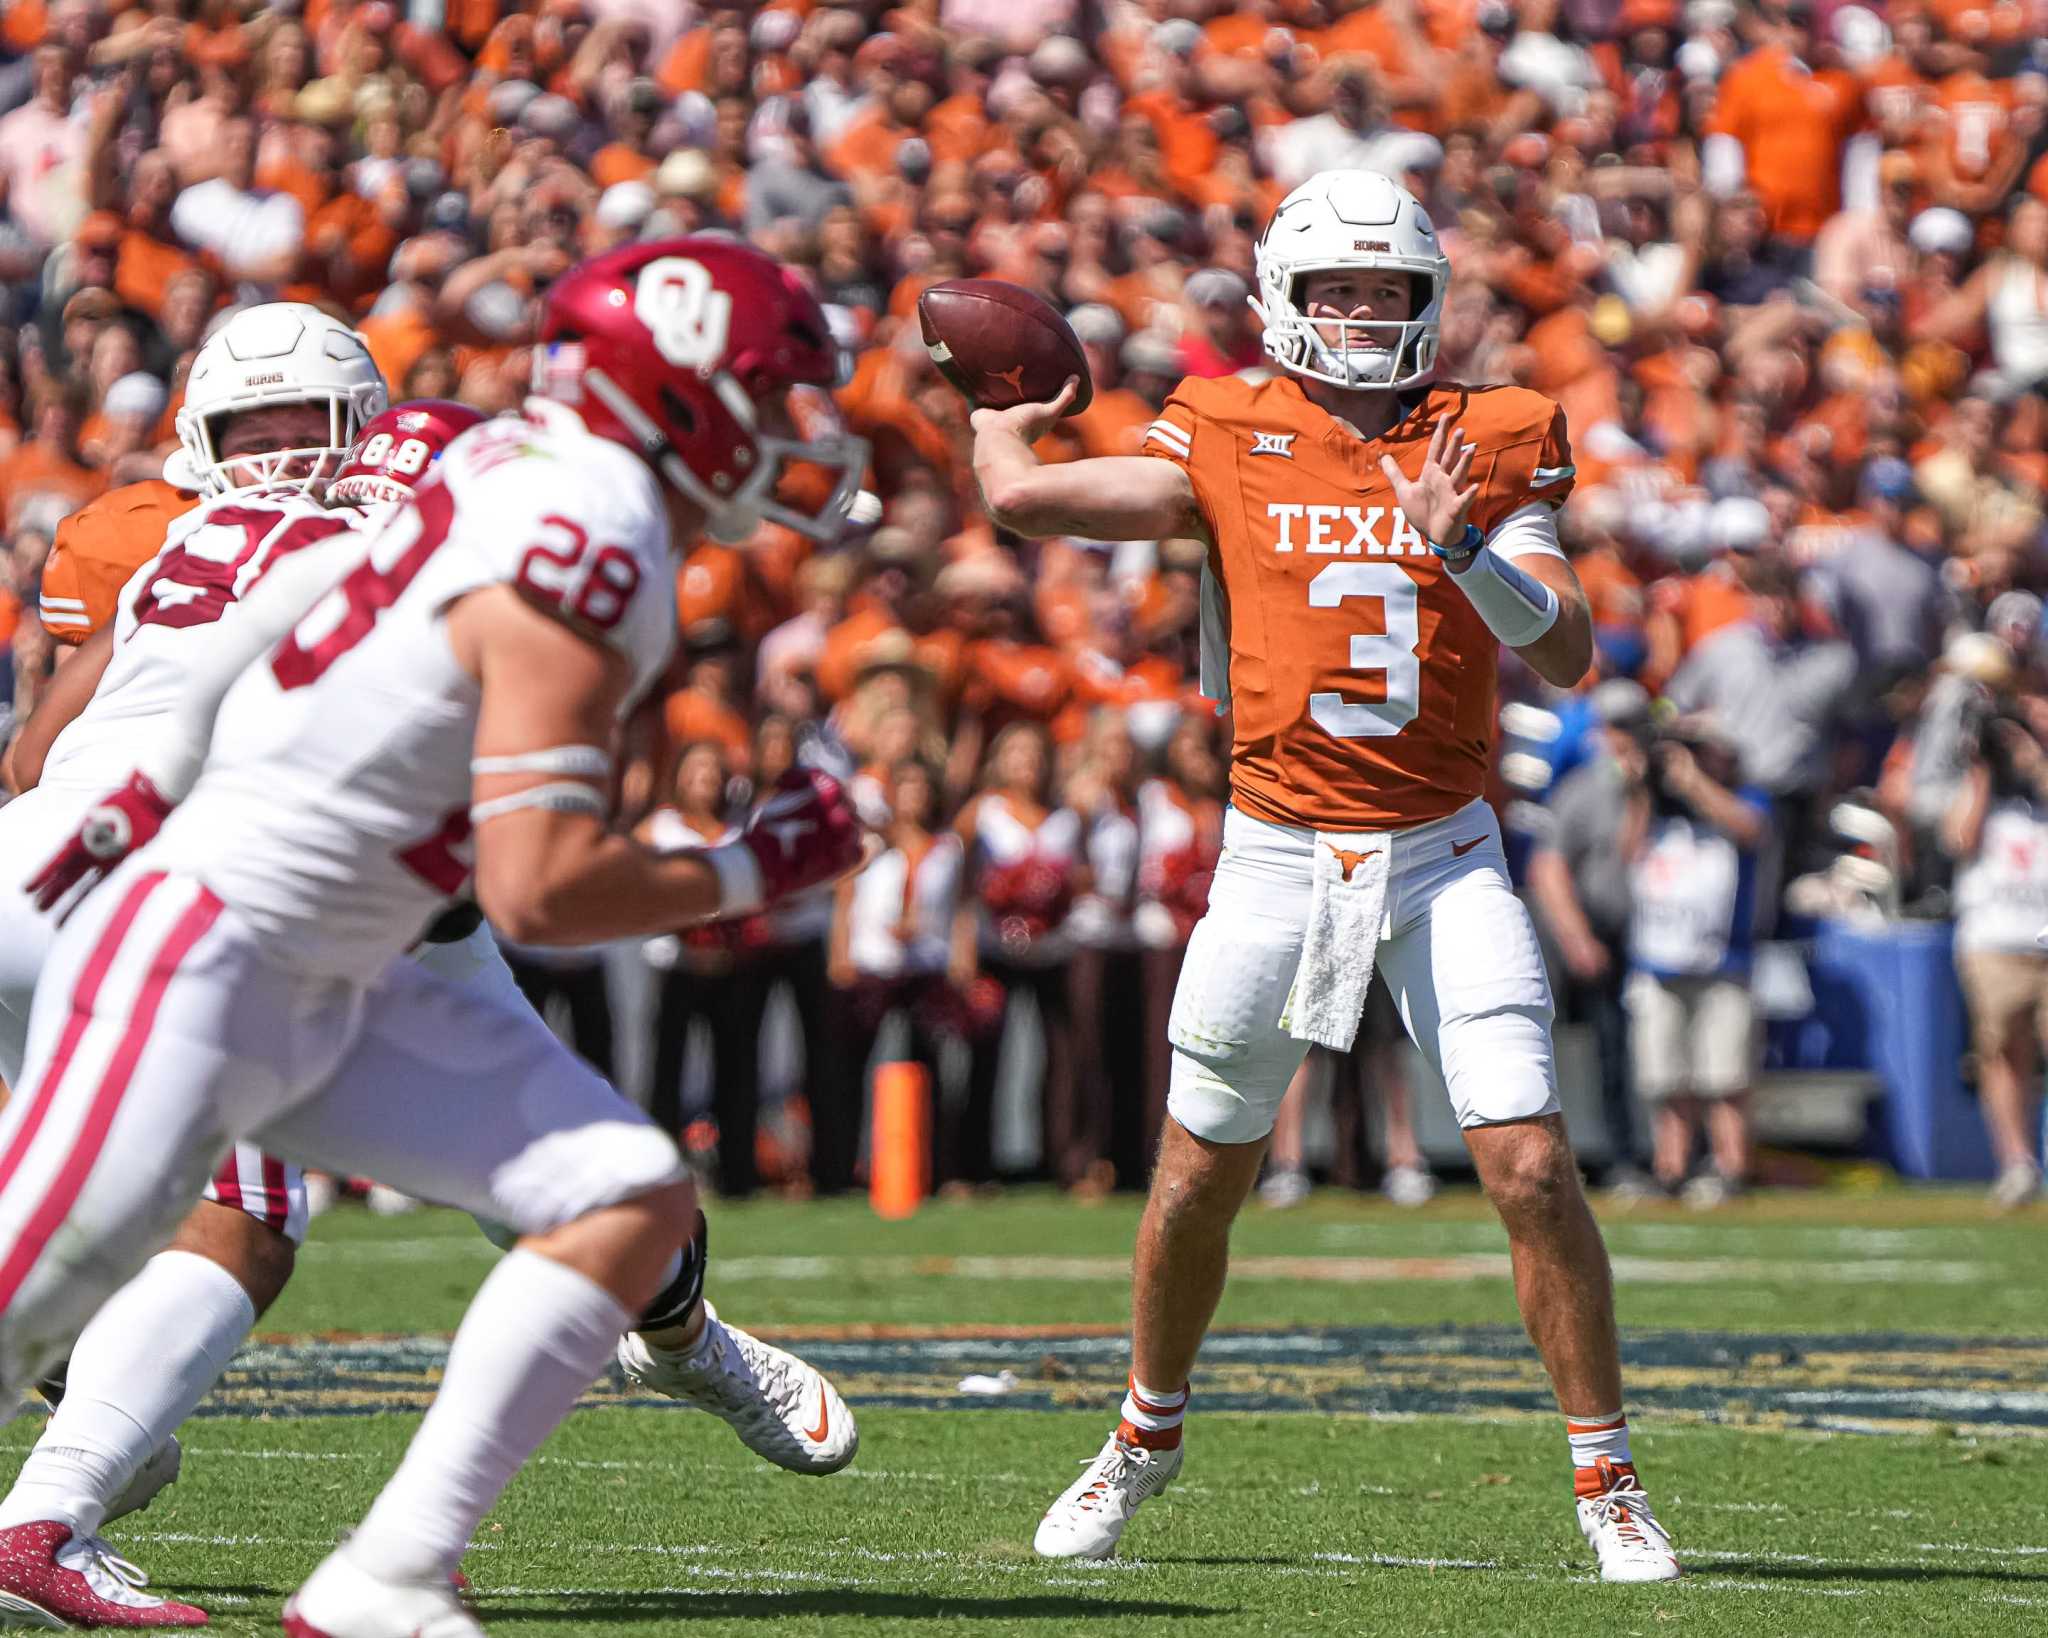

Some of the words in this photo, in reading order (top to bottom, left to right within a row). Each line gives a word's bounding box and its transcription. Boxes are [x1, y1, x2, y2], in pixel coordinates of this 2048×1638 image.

[360, 433, 429, 475] 88
[1250, 431, 1296, 459] XII
[1267, 503, 1437, 556] TEXA
[515, 513, 641, 629] 28
[1308, 562, 1420, 737] 3
